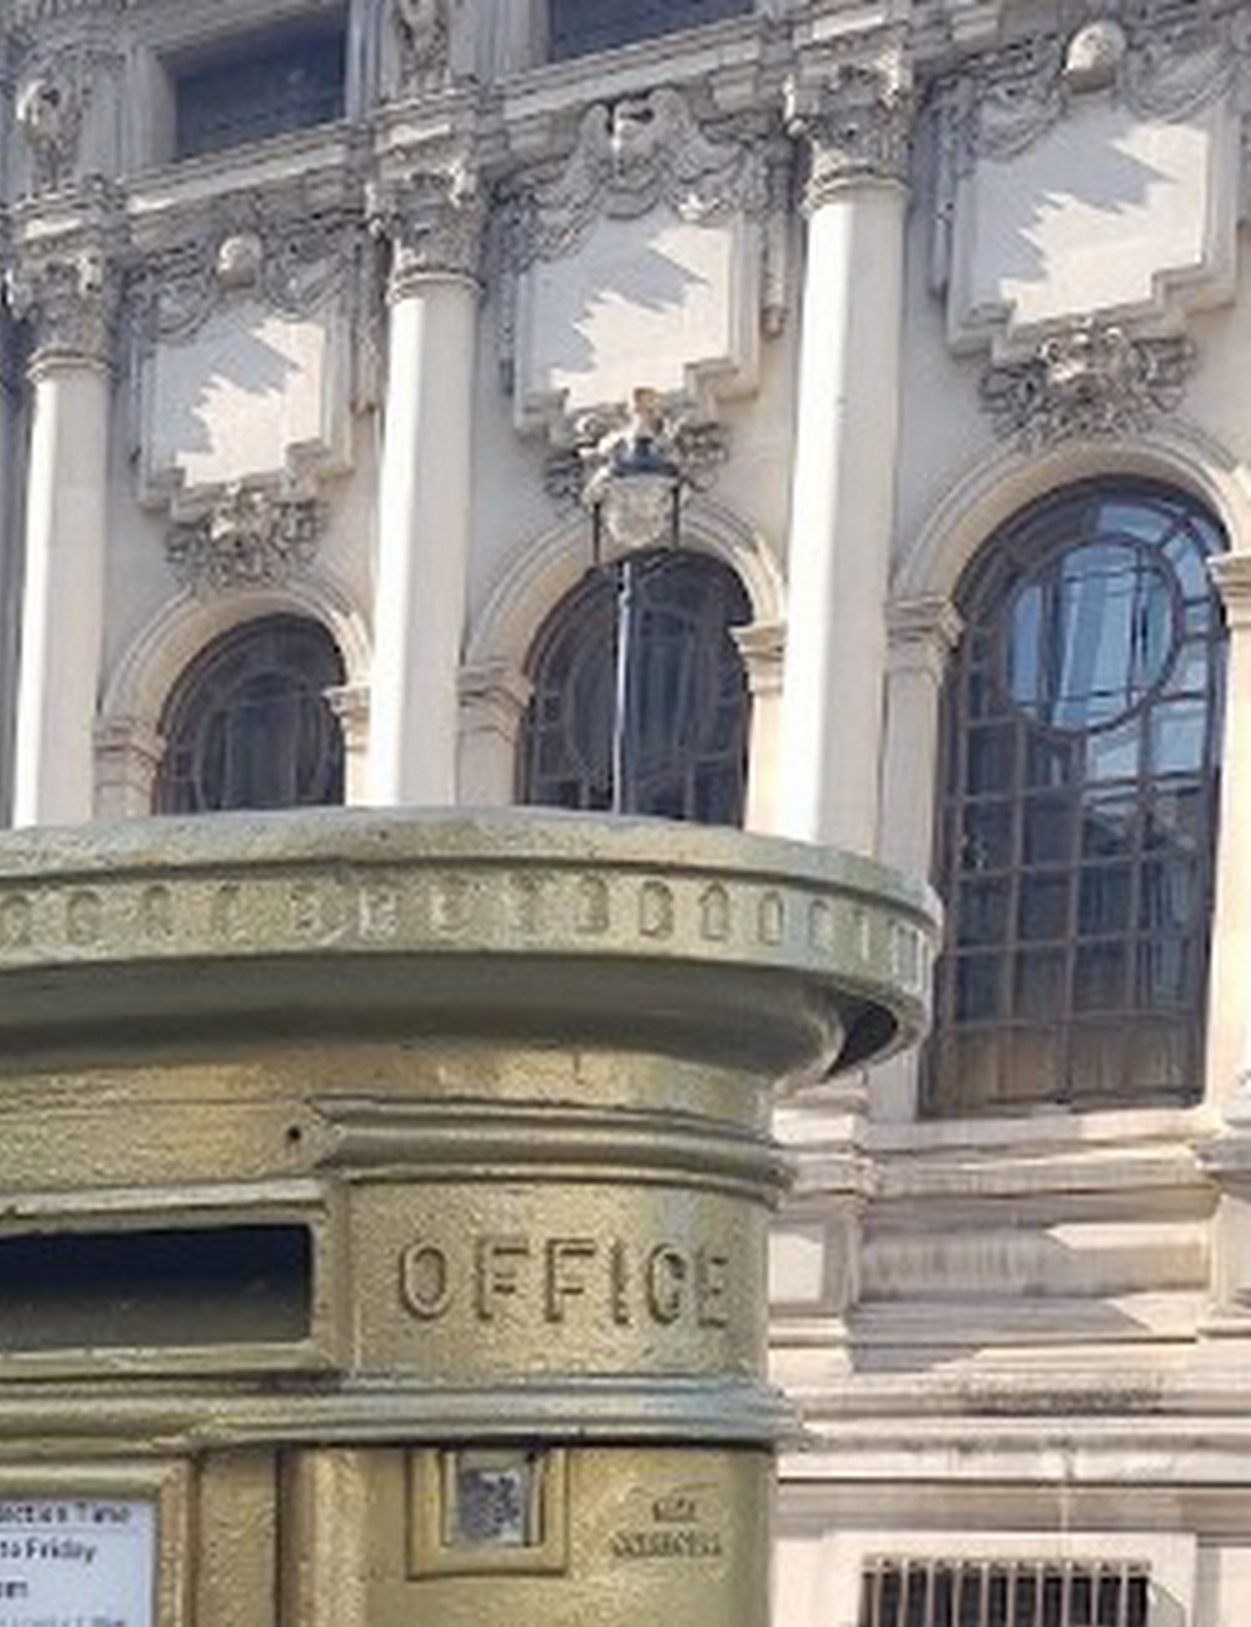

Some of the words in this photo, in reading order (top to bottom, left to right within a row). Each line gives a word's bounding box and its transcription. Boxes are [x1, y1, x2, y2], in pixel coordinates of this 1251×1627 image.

[398, 1234, 731, 1329] OFFICE
[0, 1539, 22, 1560] to
[25, 1537, 97, 1563] Friday
